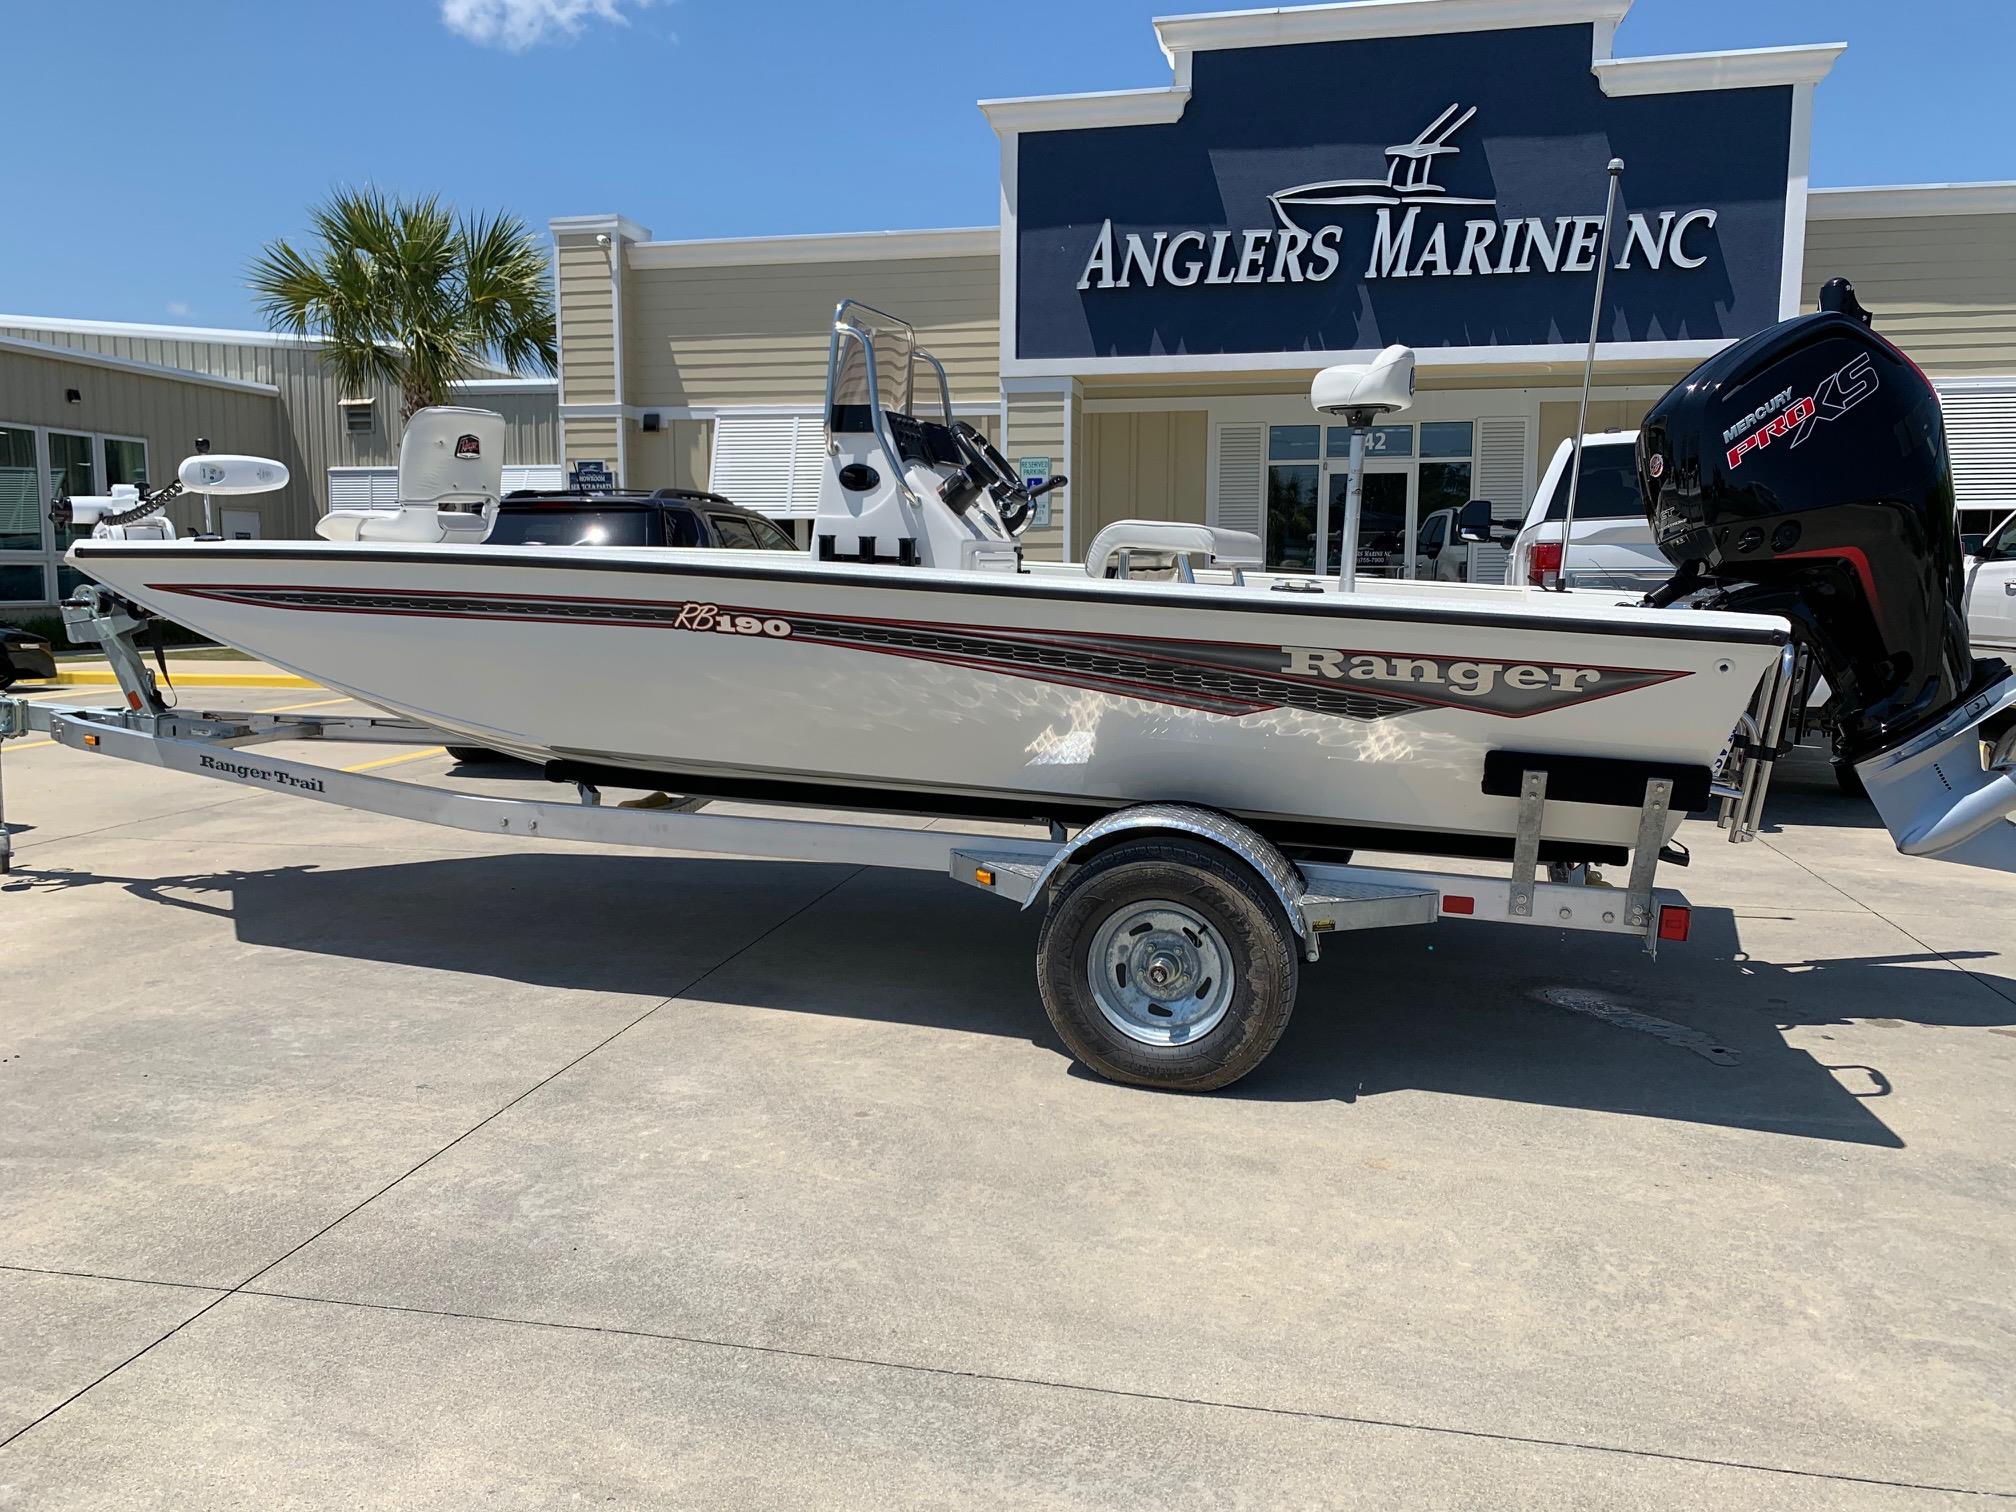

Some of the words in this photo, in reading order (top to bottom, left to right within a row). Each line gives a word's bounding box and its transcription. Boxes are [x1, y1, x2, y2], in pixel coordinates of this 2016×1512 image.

[1076, 218, 1343, 290] ANGLERS
[1364, 206, 1605, 279] MARINE
[1614, 208, 1718, 270] NC
[1722, 385, 1793, 445] MERCURY
[1281, 645, 1601, 696] Ranger
[199, 754, 271, 781] Ranger
[273, 770, 326, 793] Trail
